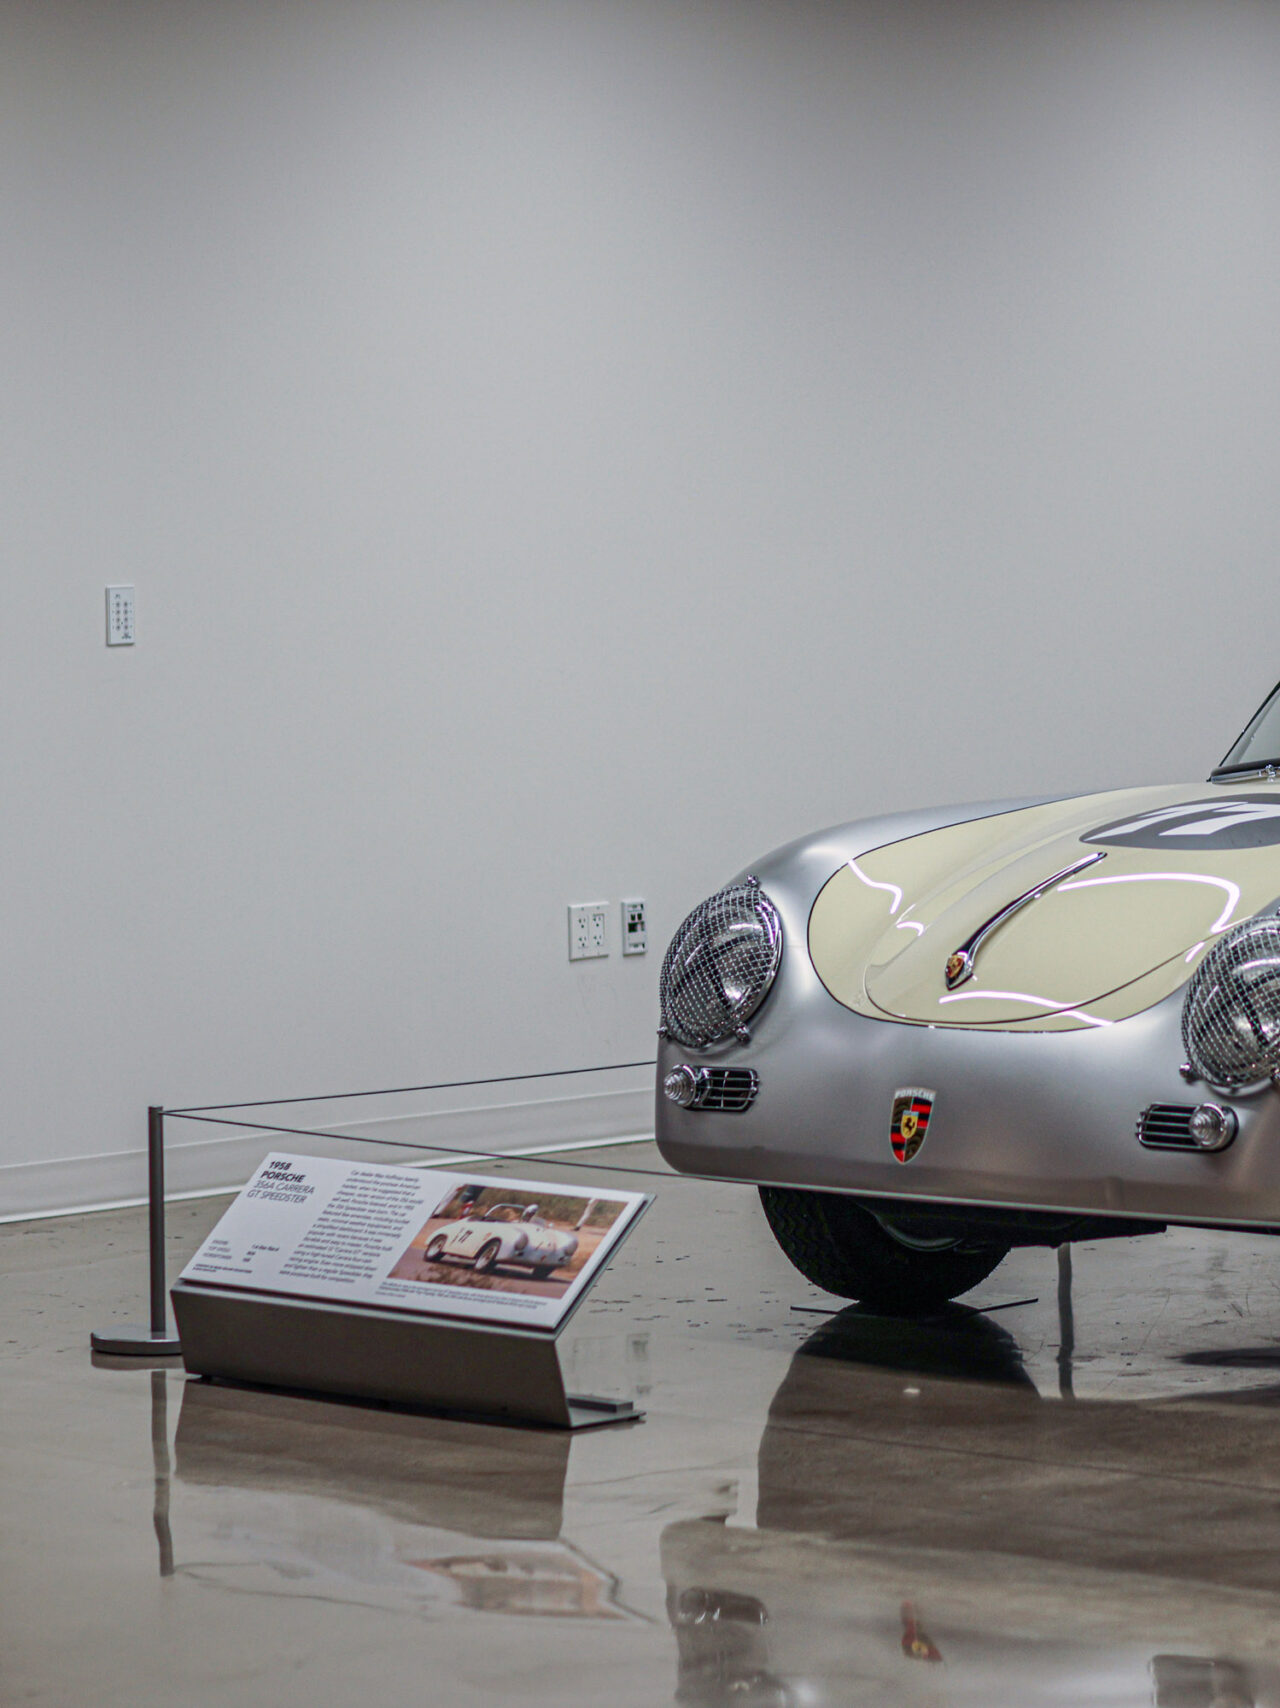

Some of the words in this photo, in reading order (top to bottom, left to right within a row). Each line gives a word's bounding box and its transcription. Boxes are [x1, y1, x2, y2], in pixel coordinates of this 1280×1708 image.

[895, 1088, 936, 1101] PORSCHE
[269, 1161, 293, 1170] 1958
[261, 1171, 306, 1183] PORSCHE
[254, 1180, 276, 1189] 356A
[275, 1182, 316, 1194] CARRERA
[247, 1189, 262, 1198] GT
[262, 1191, 307, 1203] SPEEDSTER
